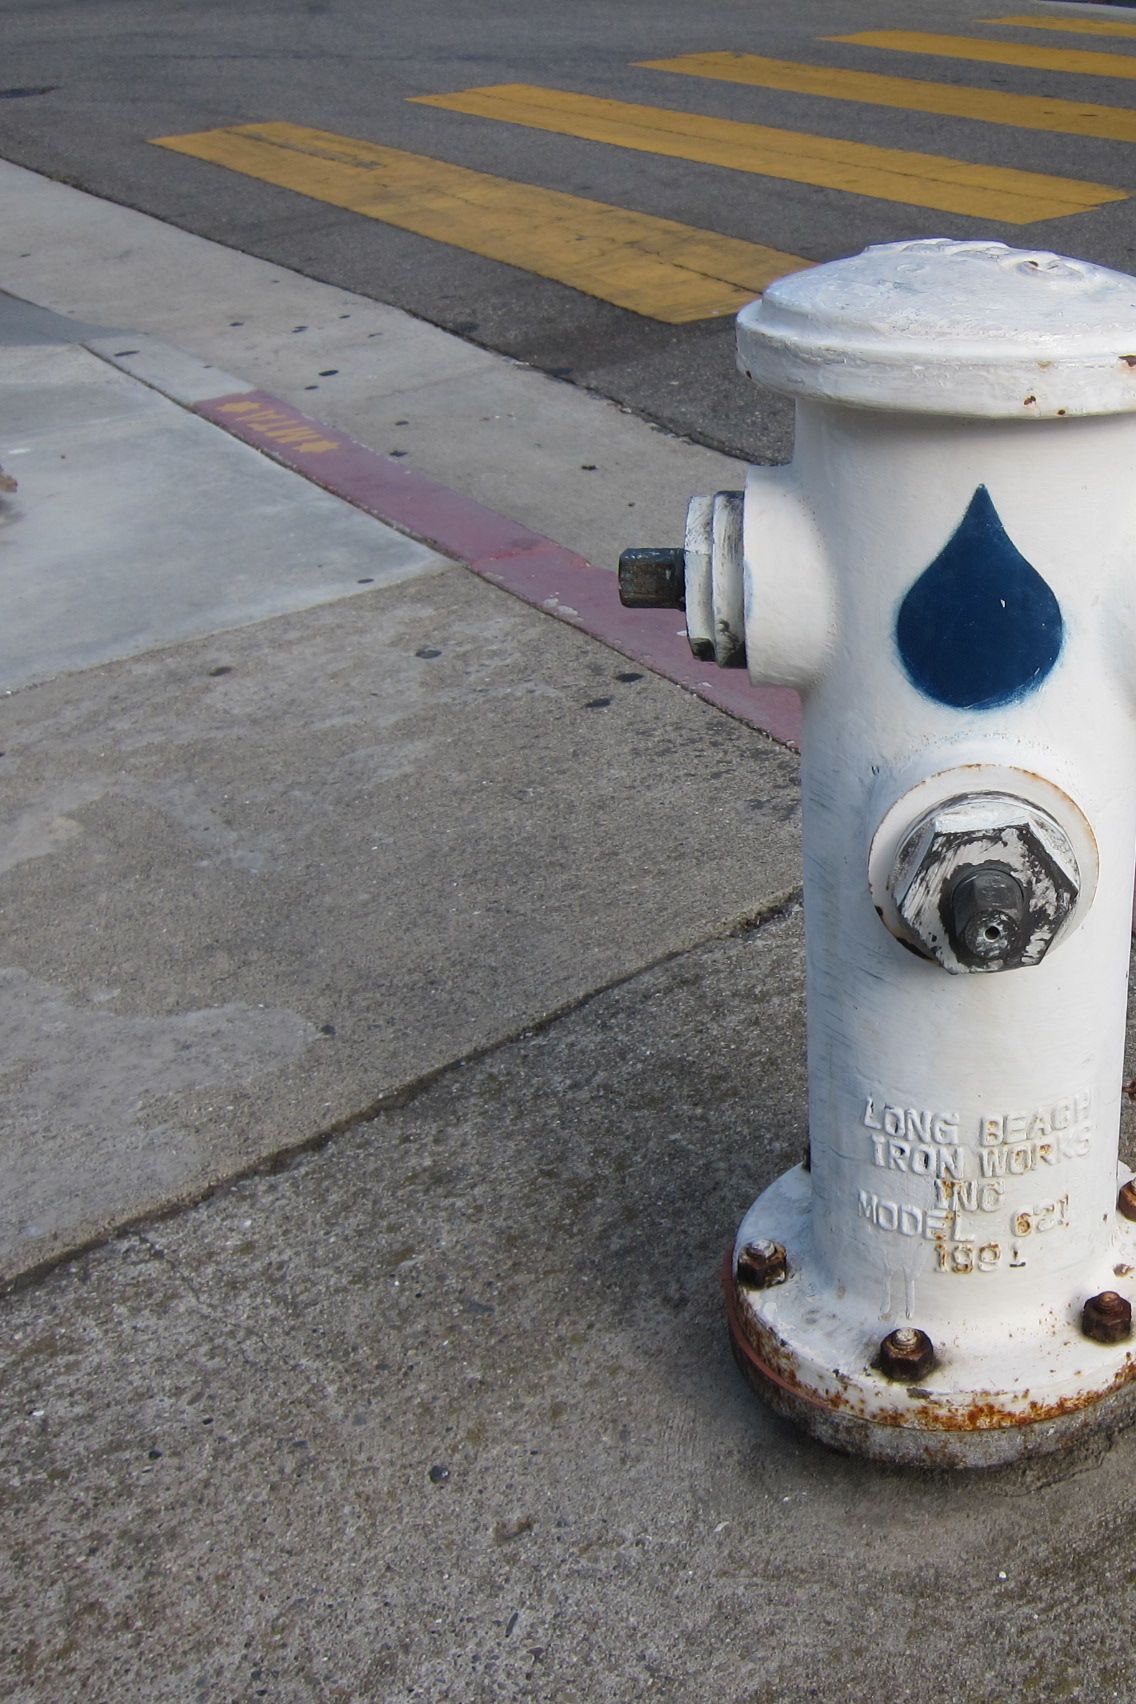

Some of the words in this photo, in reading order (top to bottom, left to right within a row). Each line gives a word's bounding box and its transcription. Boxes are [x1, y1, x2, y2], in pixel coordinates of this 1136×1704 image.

[863, 1096, 960, 1144] LONG
[981, 1089, 1092, 1146] BEACH
[872, 1133, 963, 1179] IRON
[979, 1122, 1091, 1178] WORKS
[858, 1190, 975, 1243] MODEL
[1011, 1193, 1070, 1237] 621
[935, 1178, 1004, 1213] INC
